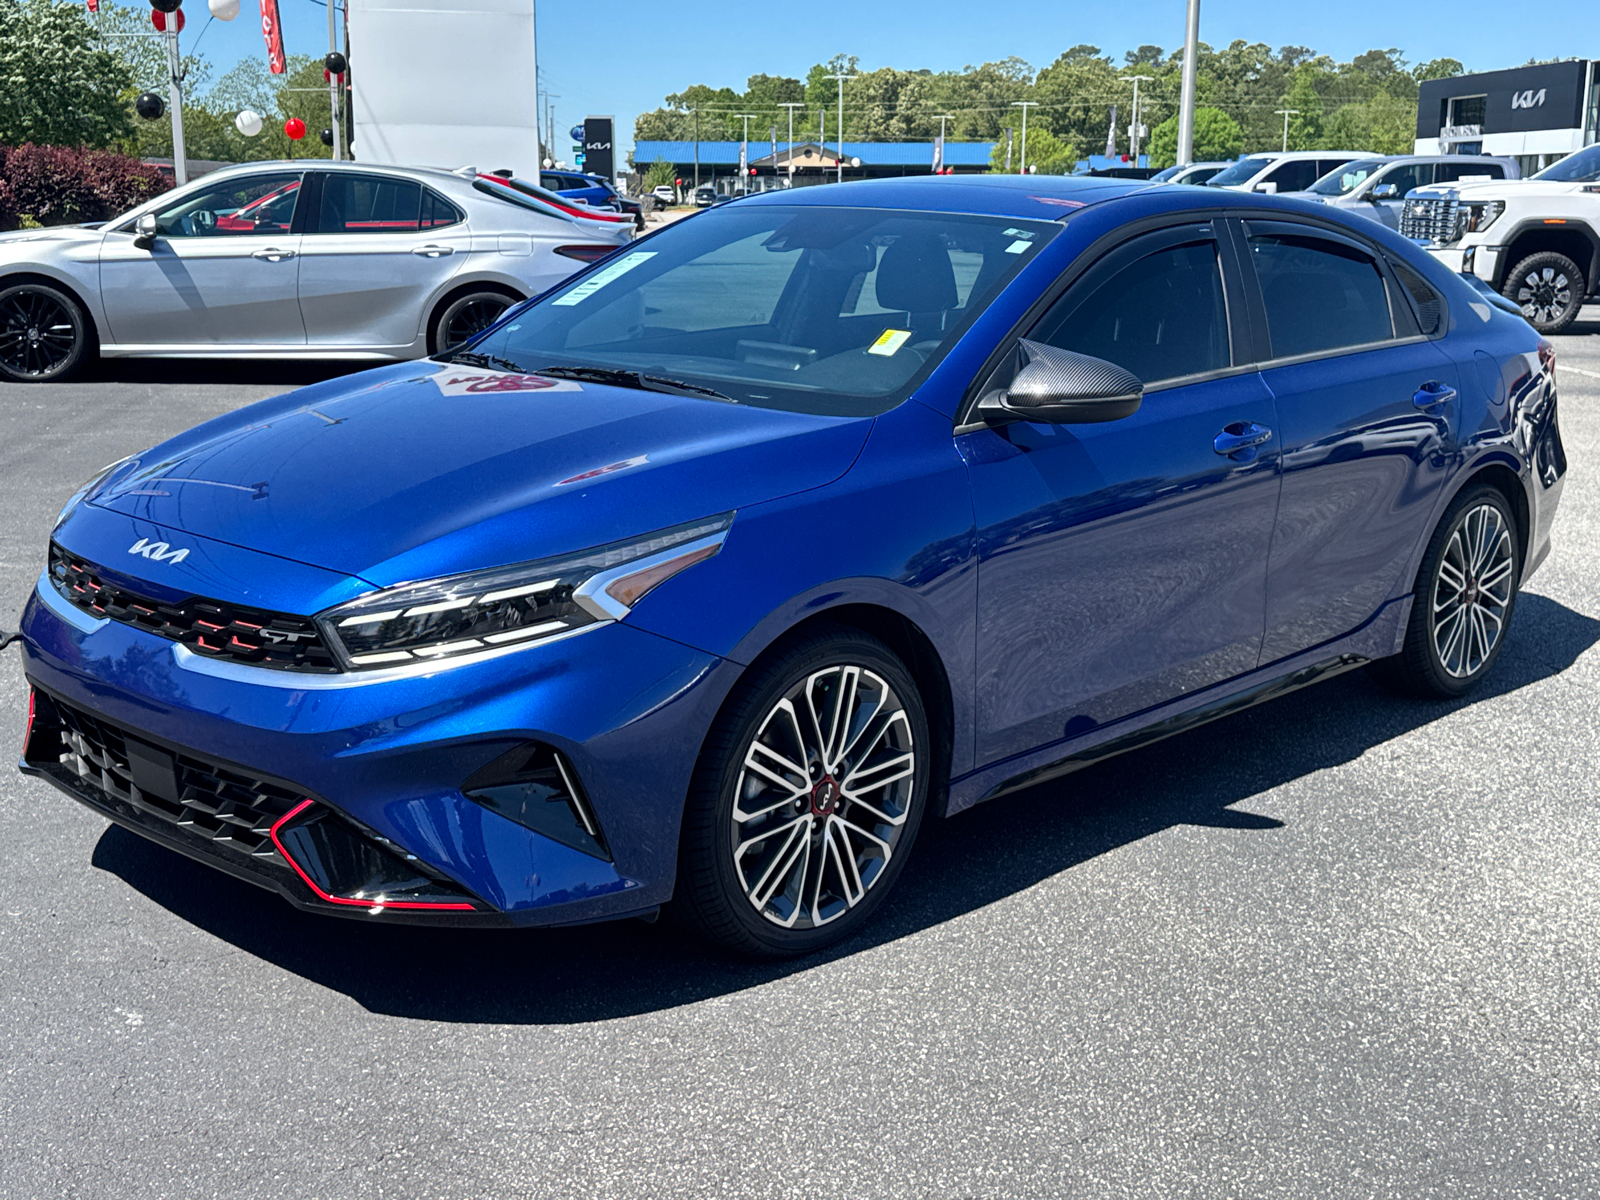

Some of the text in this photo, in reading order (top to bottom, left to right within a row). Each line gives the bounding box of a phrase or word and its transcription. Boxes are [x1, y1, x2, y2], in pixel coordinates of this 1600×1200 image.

[1512, 88, 1547, 109] KIA
[128, 538, 190, 564] KIA
[259, 628, 317, 643] GT
